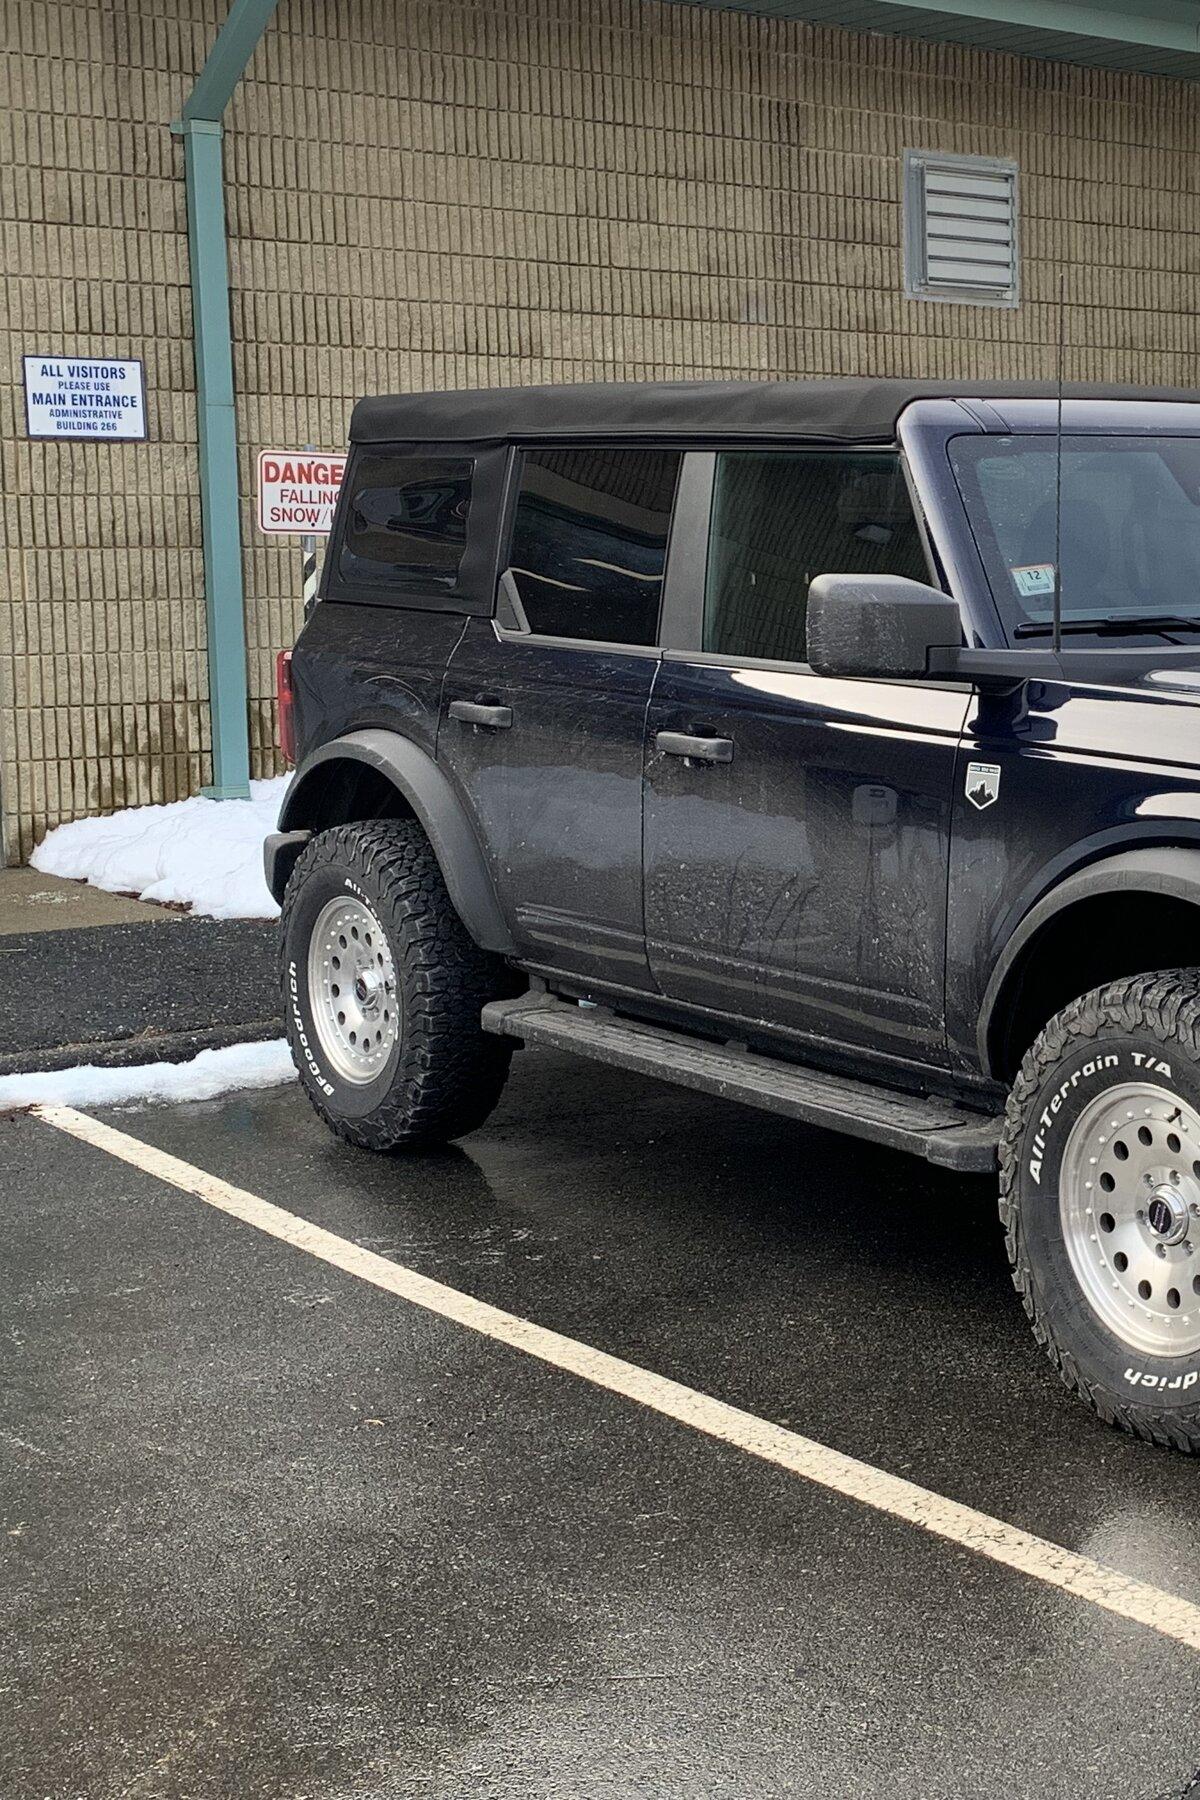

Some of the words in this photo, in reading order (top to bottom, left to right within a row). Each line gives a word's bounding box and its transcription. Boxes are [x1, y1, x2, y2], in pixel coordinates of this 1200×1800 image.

[40, 364, 64, 377] ALL
[67, 365, 126, 379] VISITORS
[58, 381, 91, 391] PLEASE
[93, 382, 110, 391] USE
[32, 392, 66, 405] MAIN
[71, 393, 138, 408] ENTRANCE
[49, 408, 123, 419] ADMINISTRATIVE
[56, 420, 98, 430] BUILDING
[100, 422, 117, 431] 266
[264, 461, 344, 485] DANGE
[1027, 570, 1042, 580] 12
[289, 961, 334, 1097] BFGoodrich
[1029, 1054, 1119, 1185] All-Terrain
[1131, 1052, 1172, 1079] T/A
